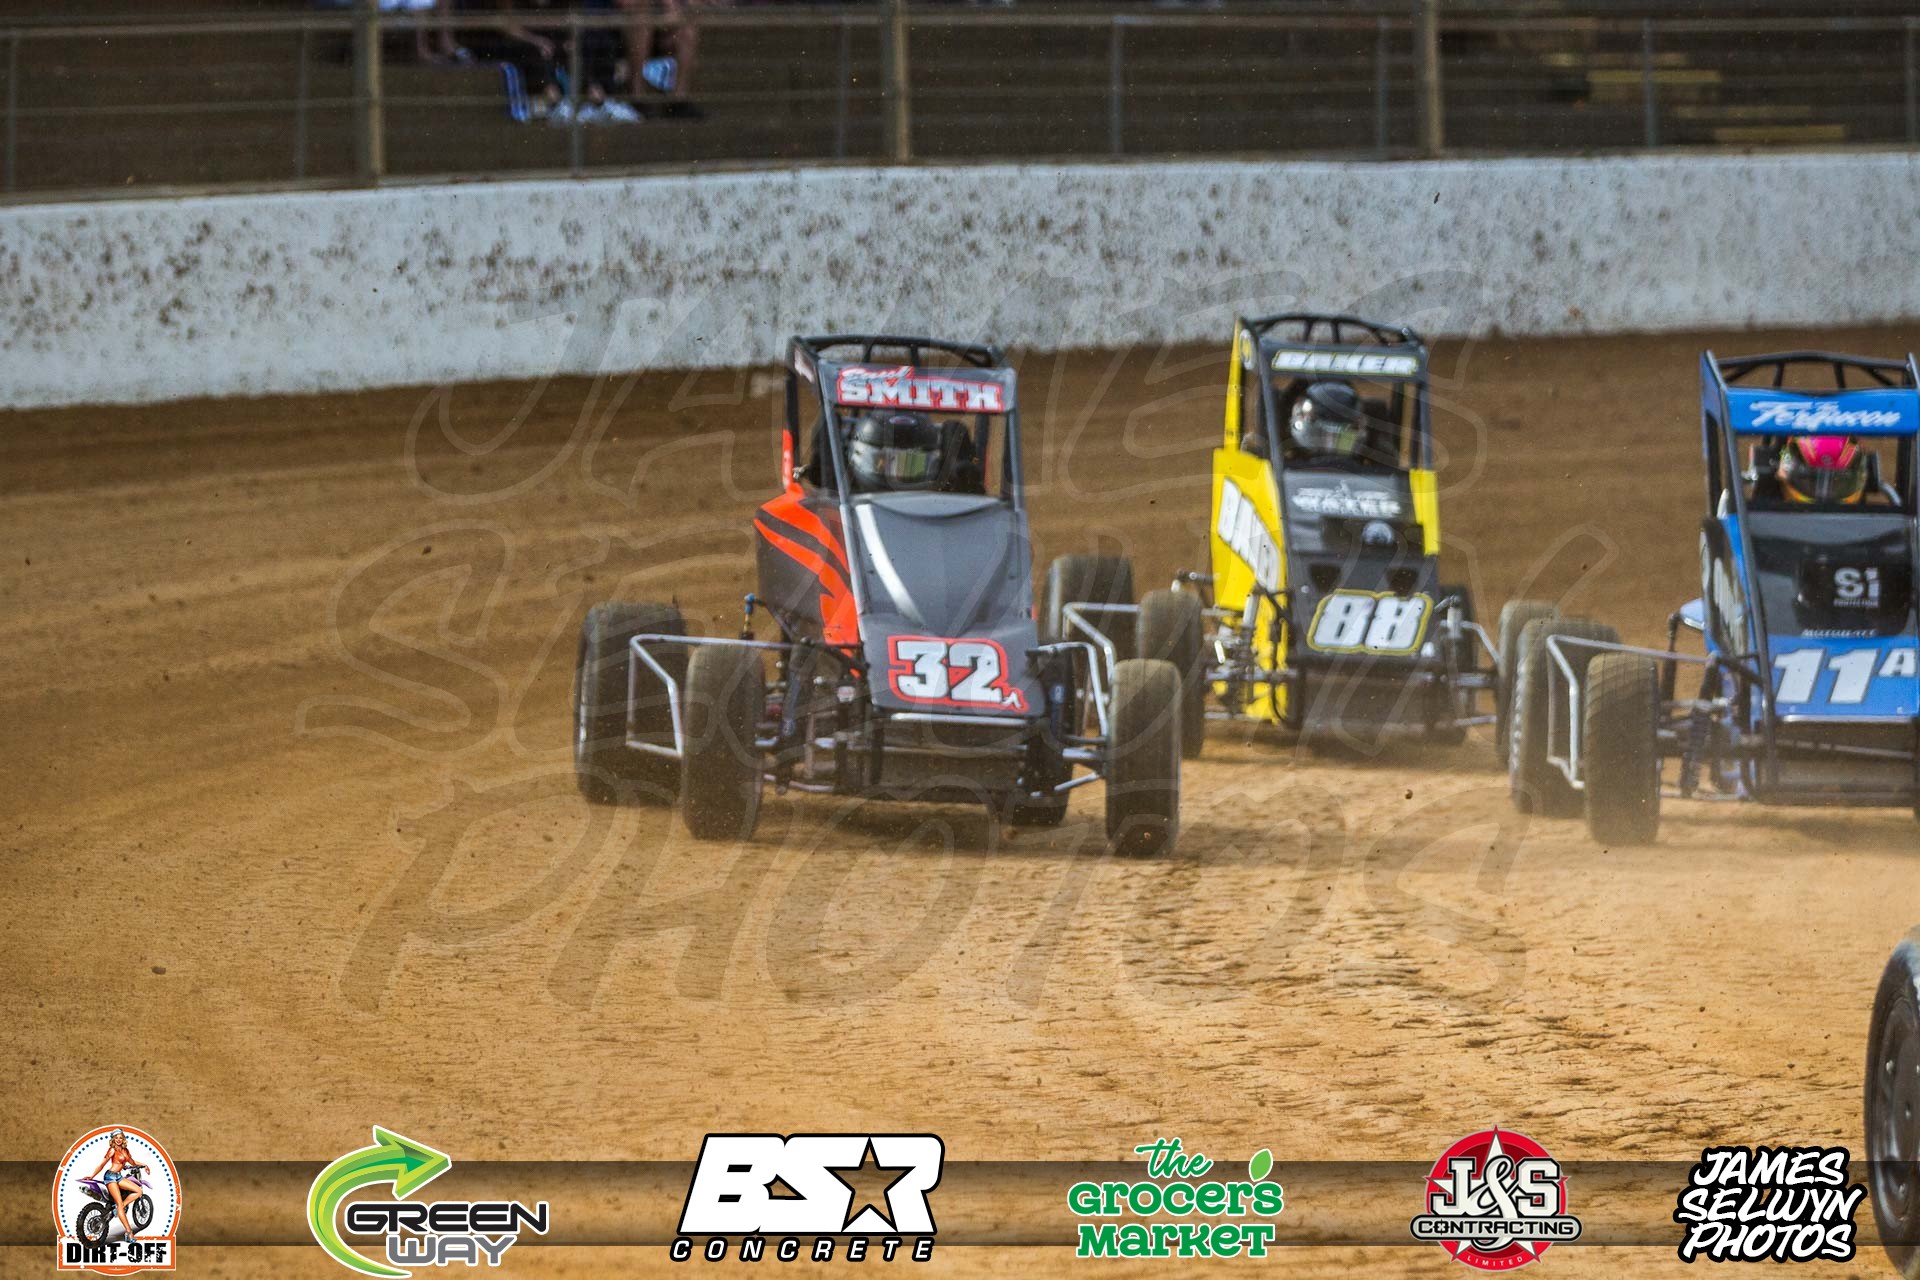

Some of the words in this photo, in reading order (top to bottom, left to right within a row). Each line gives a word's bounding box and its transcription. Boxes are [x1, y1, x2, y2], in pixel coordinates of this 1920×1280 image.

[838, 378, 1002, 411] SMITH
[1313, 593, 1427, 650] 88
[1774, 649, 1917, 704] 11A
